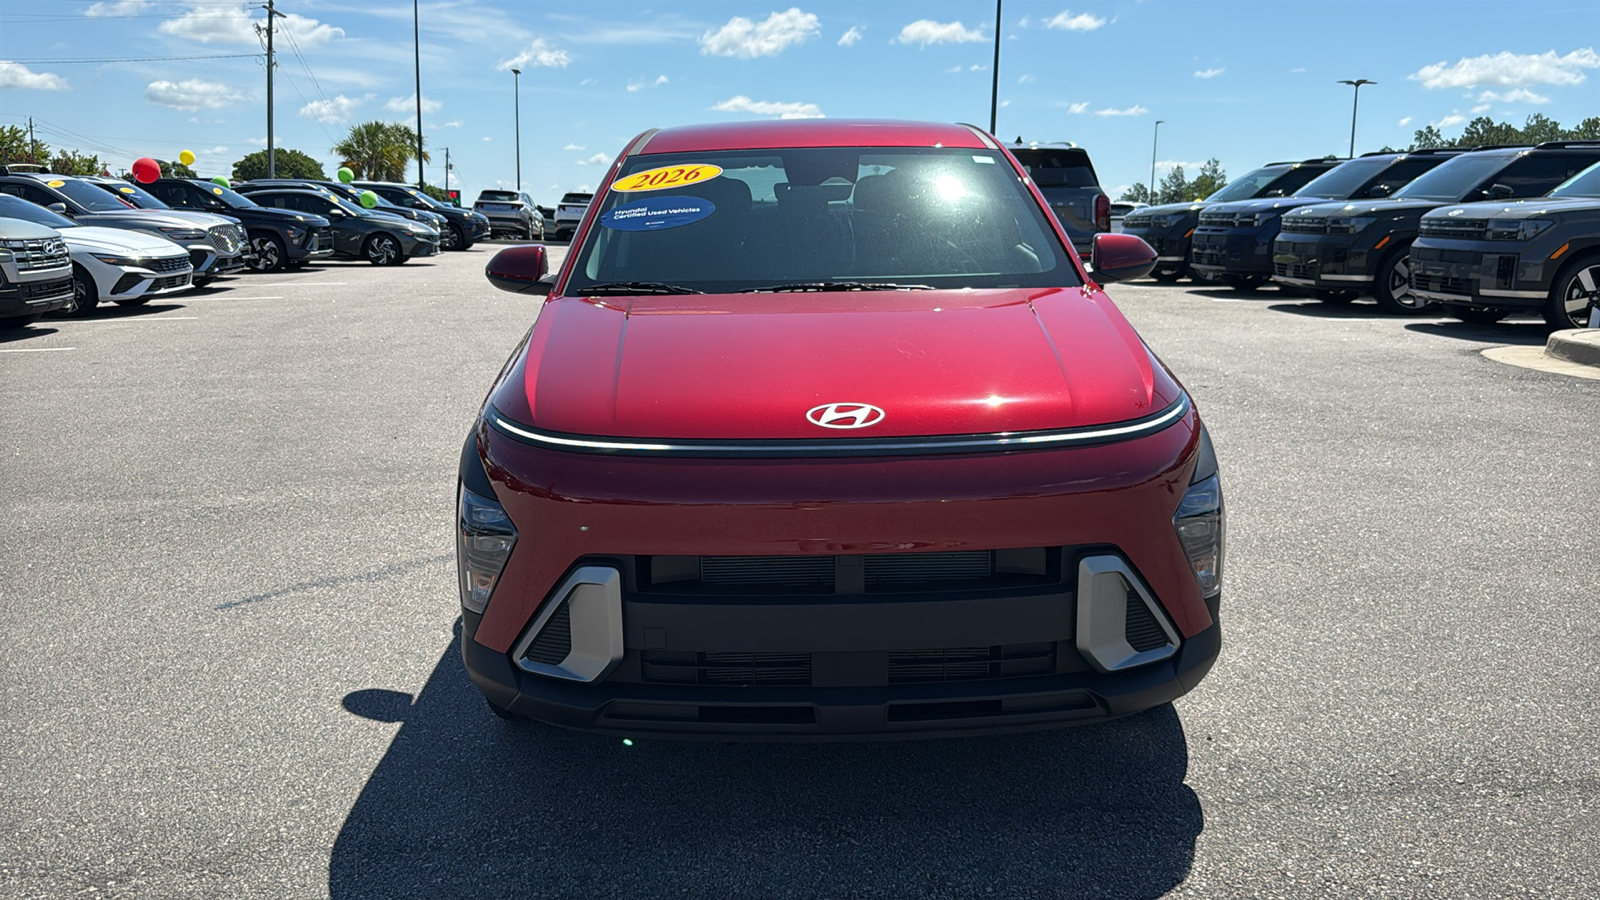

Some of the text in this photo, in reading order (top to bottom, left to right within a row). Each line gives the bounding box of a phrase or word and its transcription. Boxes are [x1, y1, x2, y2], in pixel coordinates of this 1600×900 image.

[629, 166, 705, 190] 2026
[614, 207, 648, 215] Hyundai
[613, 212, 647, 220] Certified
